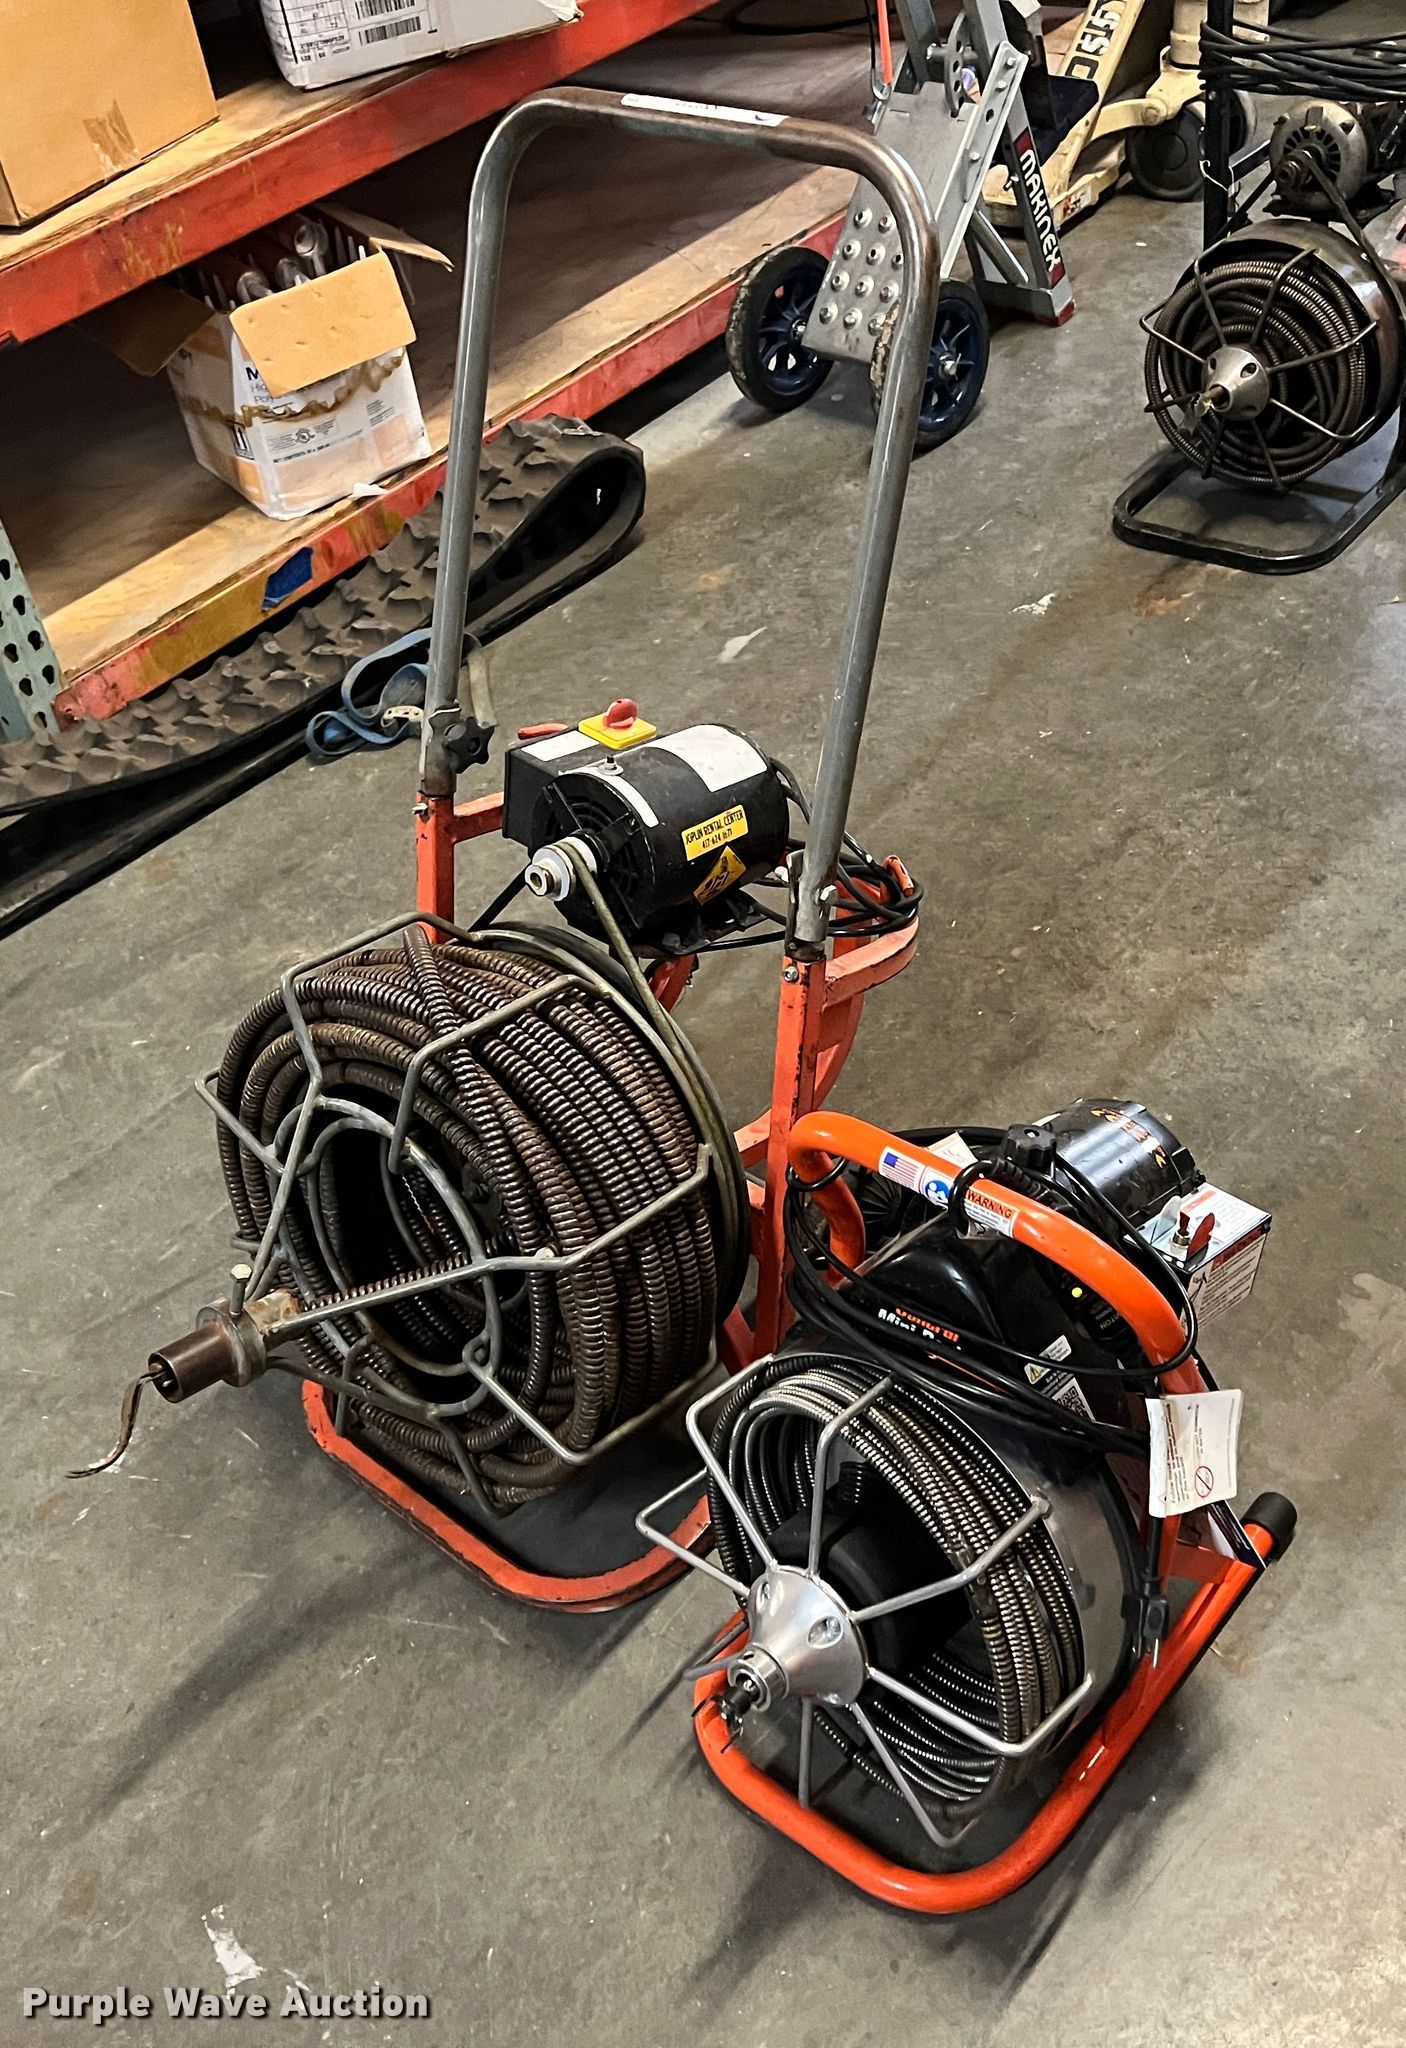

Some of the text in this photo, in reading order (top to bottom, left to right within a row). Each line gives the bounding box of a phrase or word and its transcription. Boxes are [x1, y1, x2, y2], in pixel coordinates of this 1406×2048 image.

[1020, 149, 1061, 272] MAKINEX
[686, 810, 743, 845] JOPLIN RENTAL CENTER
[966, 1189, 1013, 1219] WARNING
